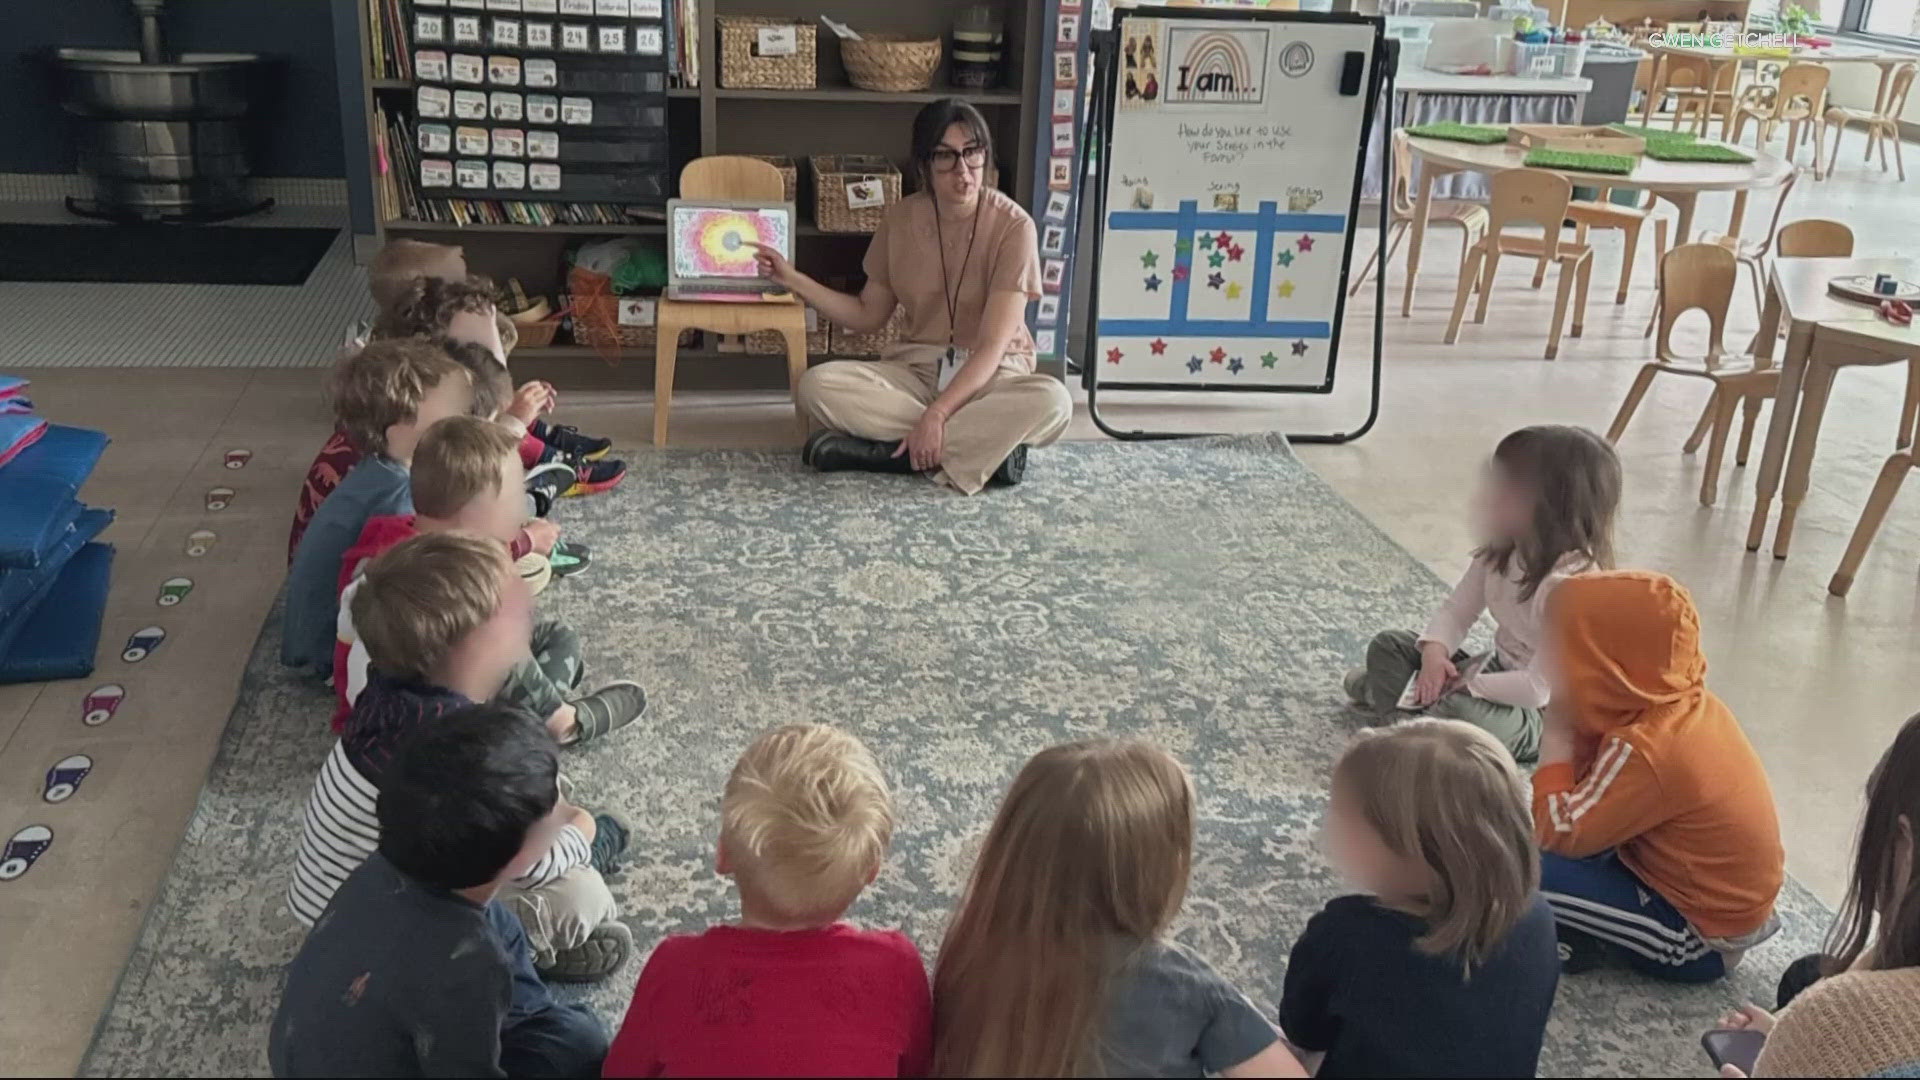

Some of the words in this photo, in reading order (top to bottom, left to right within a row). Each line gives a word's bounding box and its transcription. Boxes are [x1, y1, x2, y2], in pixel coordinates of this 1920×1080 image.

[421, 22, 439, 35] 20
[458, 23, 475, 36] 21
[497, 25, 515, 39] 22
[530, 28, 547, 41] 23
[567, 31, 583, 44] 24
[603, 33, 620, 45] 25
[640, 34, 656, 46] 26
[1177, 66, 1190, 92] I
[1177, 122, 1200, 138] How
[1201, 123, 1213, 137] do
[1215, 125, 1232, 138] you
[1256, 125, 1269, 136] to
[1272, 125, 1292, 137] use
[1187, 140, 1211, 153] your
[1252, 141, 1264, 150] in
[1265, 138, 1286, 150] the
